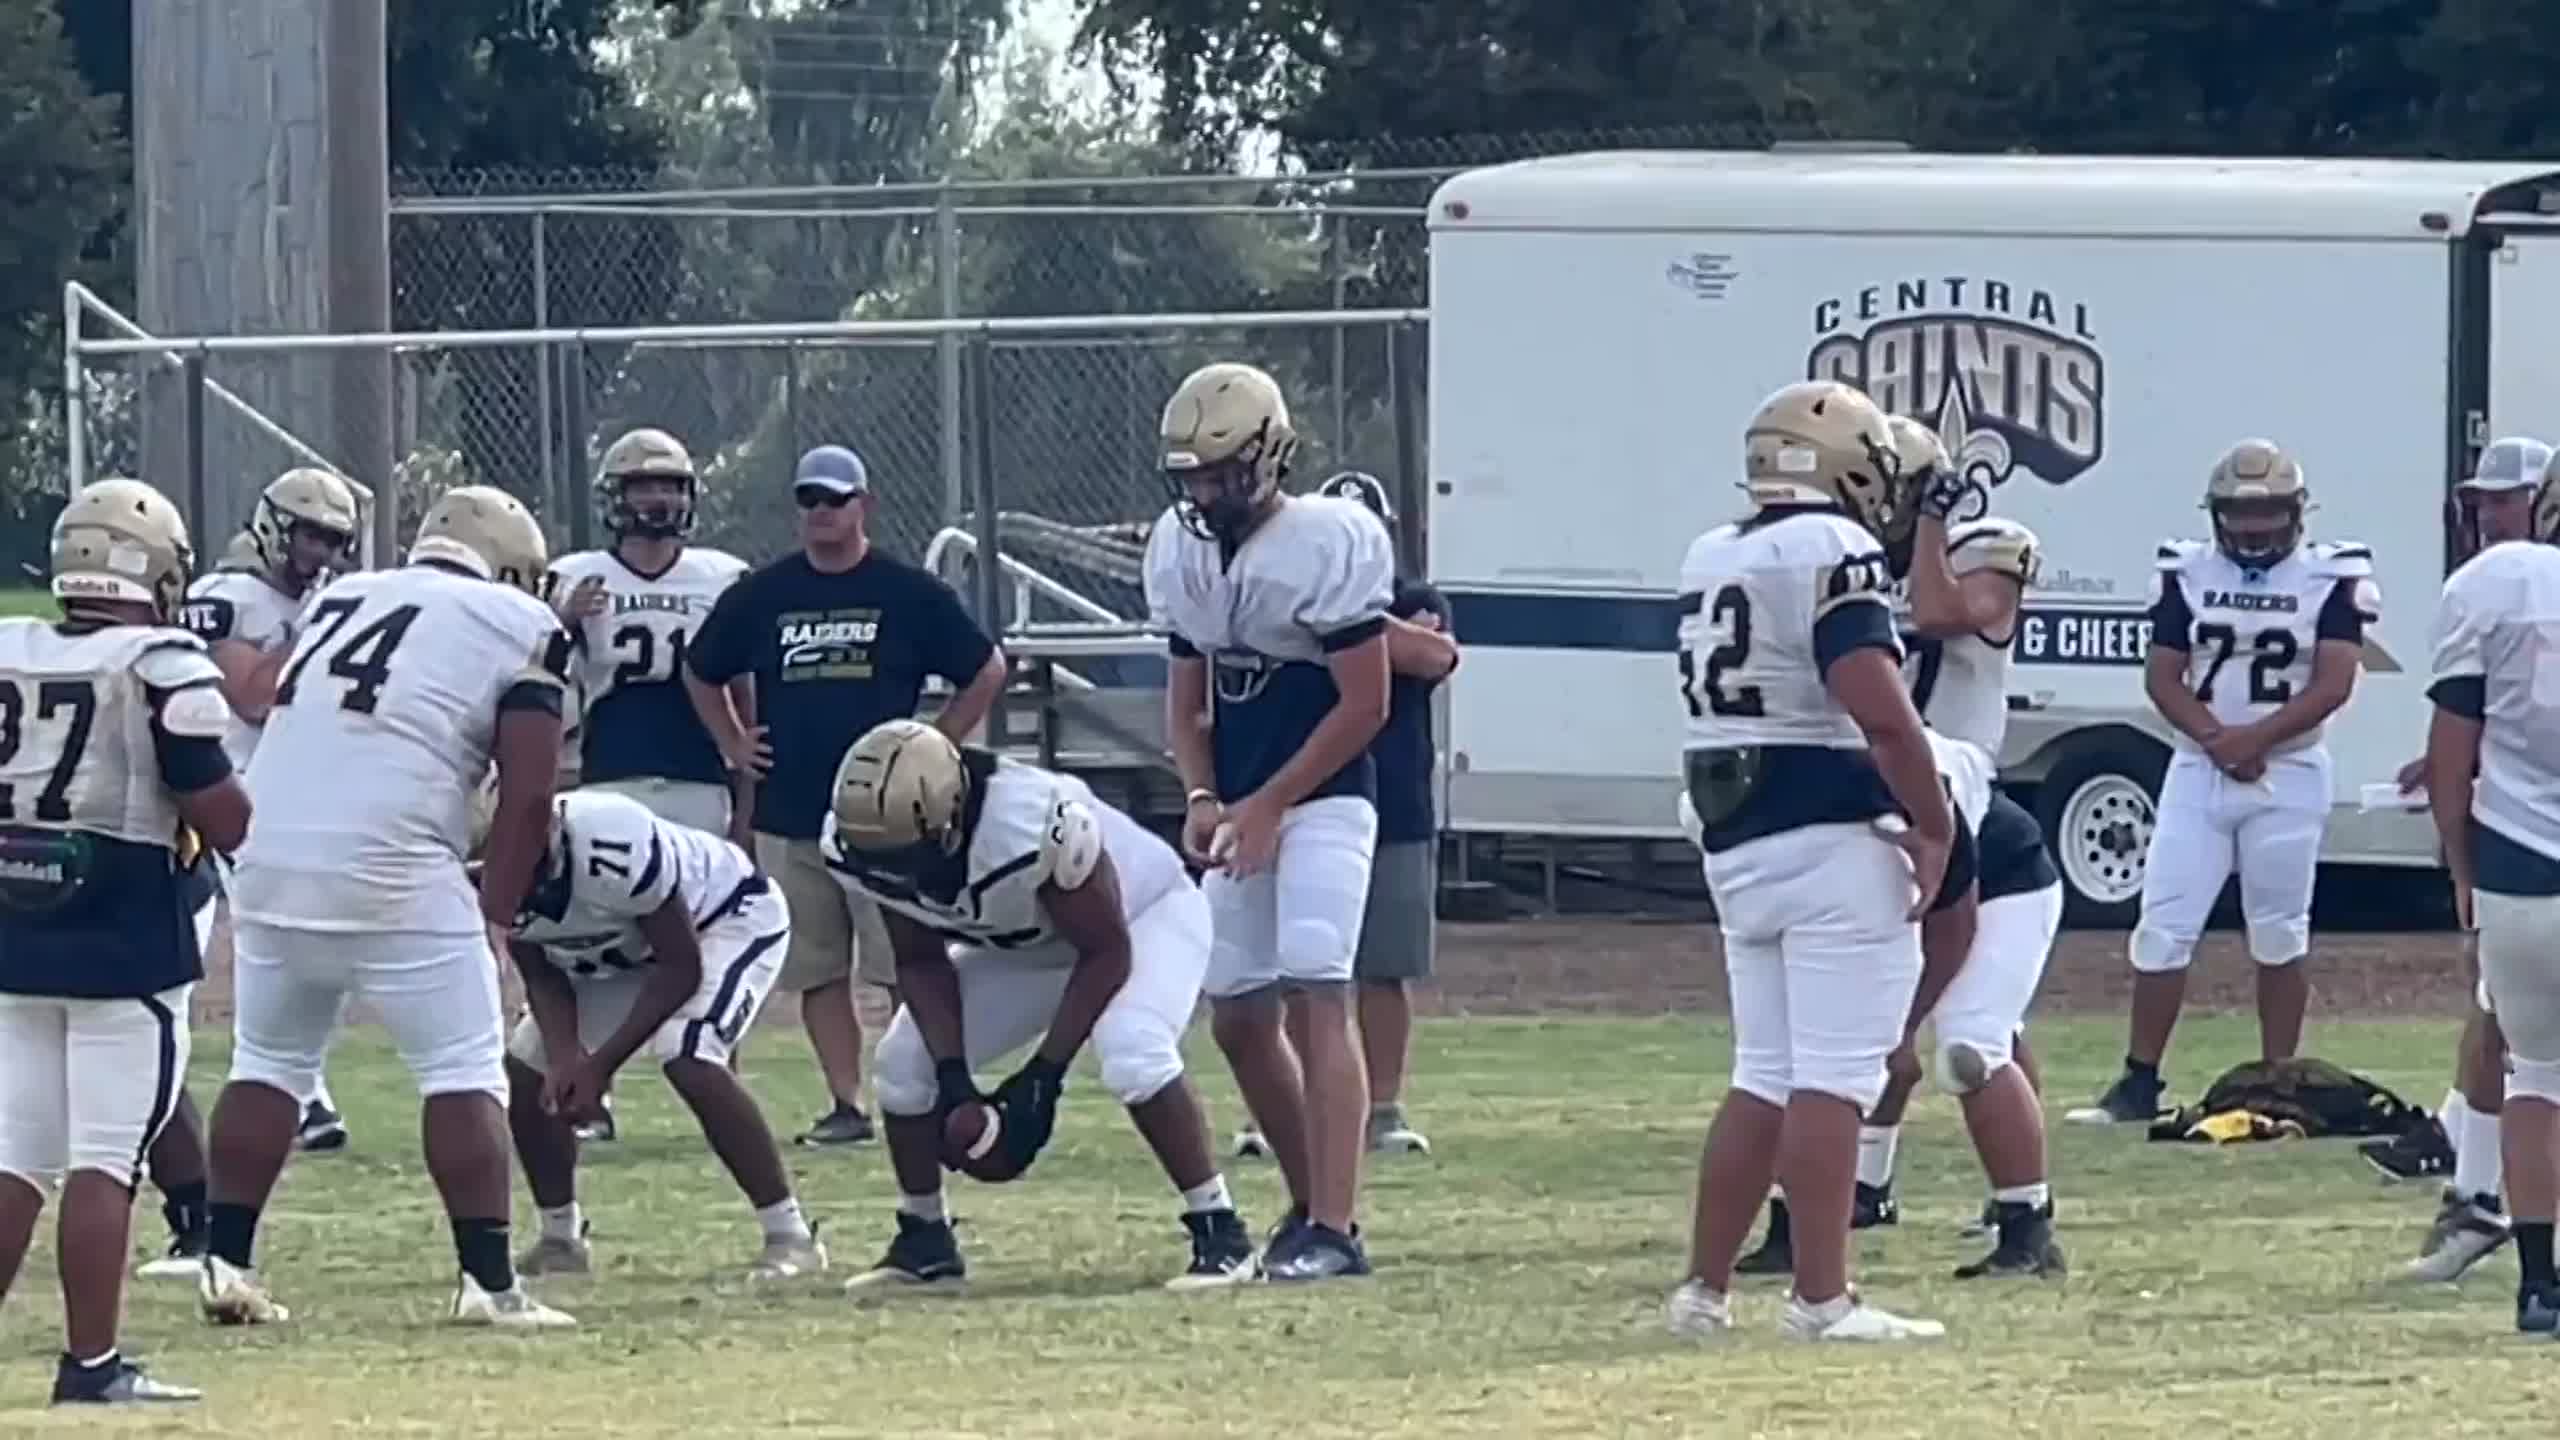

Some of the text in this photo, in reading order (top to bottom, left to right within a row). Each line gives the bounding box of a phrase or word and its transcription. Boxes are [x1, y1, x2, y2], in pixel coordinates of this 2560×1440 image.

[1815, 276, 2096, 340] CENTRAL
[2202, 590, 2298, 613] RAIDERS
[274, 595, 422, 714] 74
[613, 626, 686, 684] 21
[780, 622, 878, 646] RAIDERS
[2023, 616, 2048, 657] &
[2196, 621, 2298, 704] 72
[589, 838, 632, 878] 71
